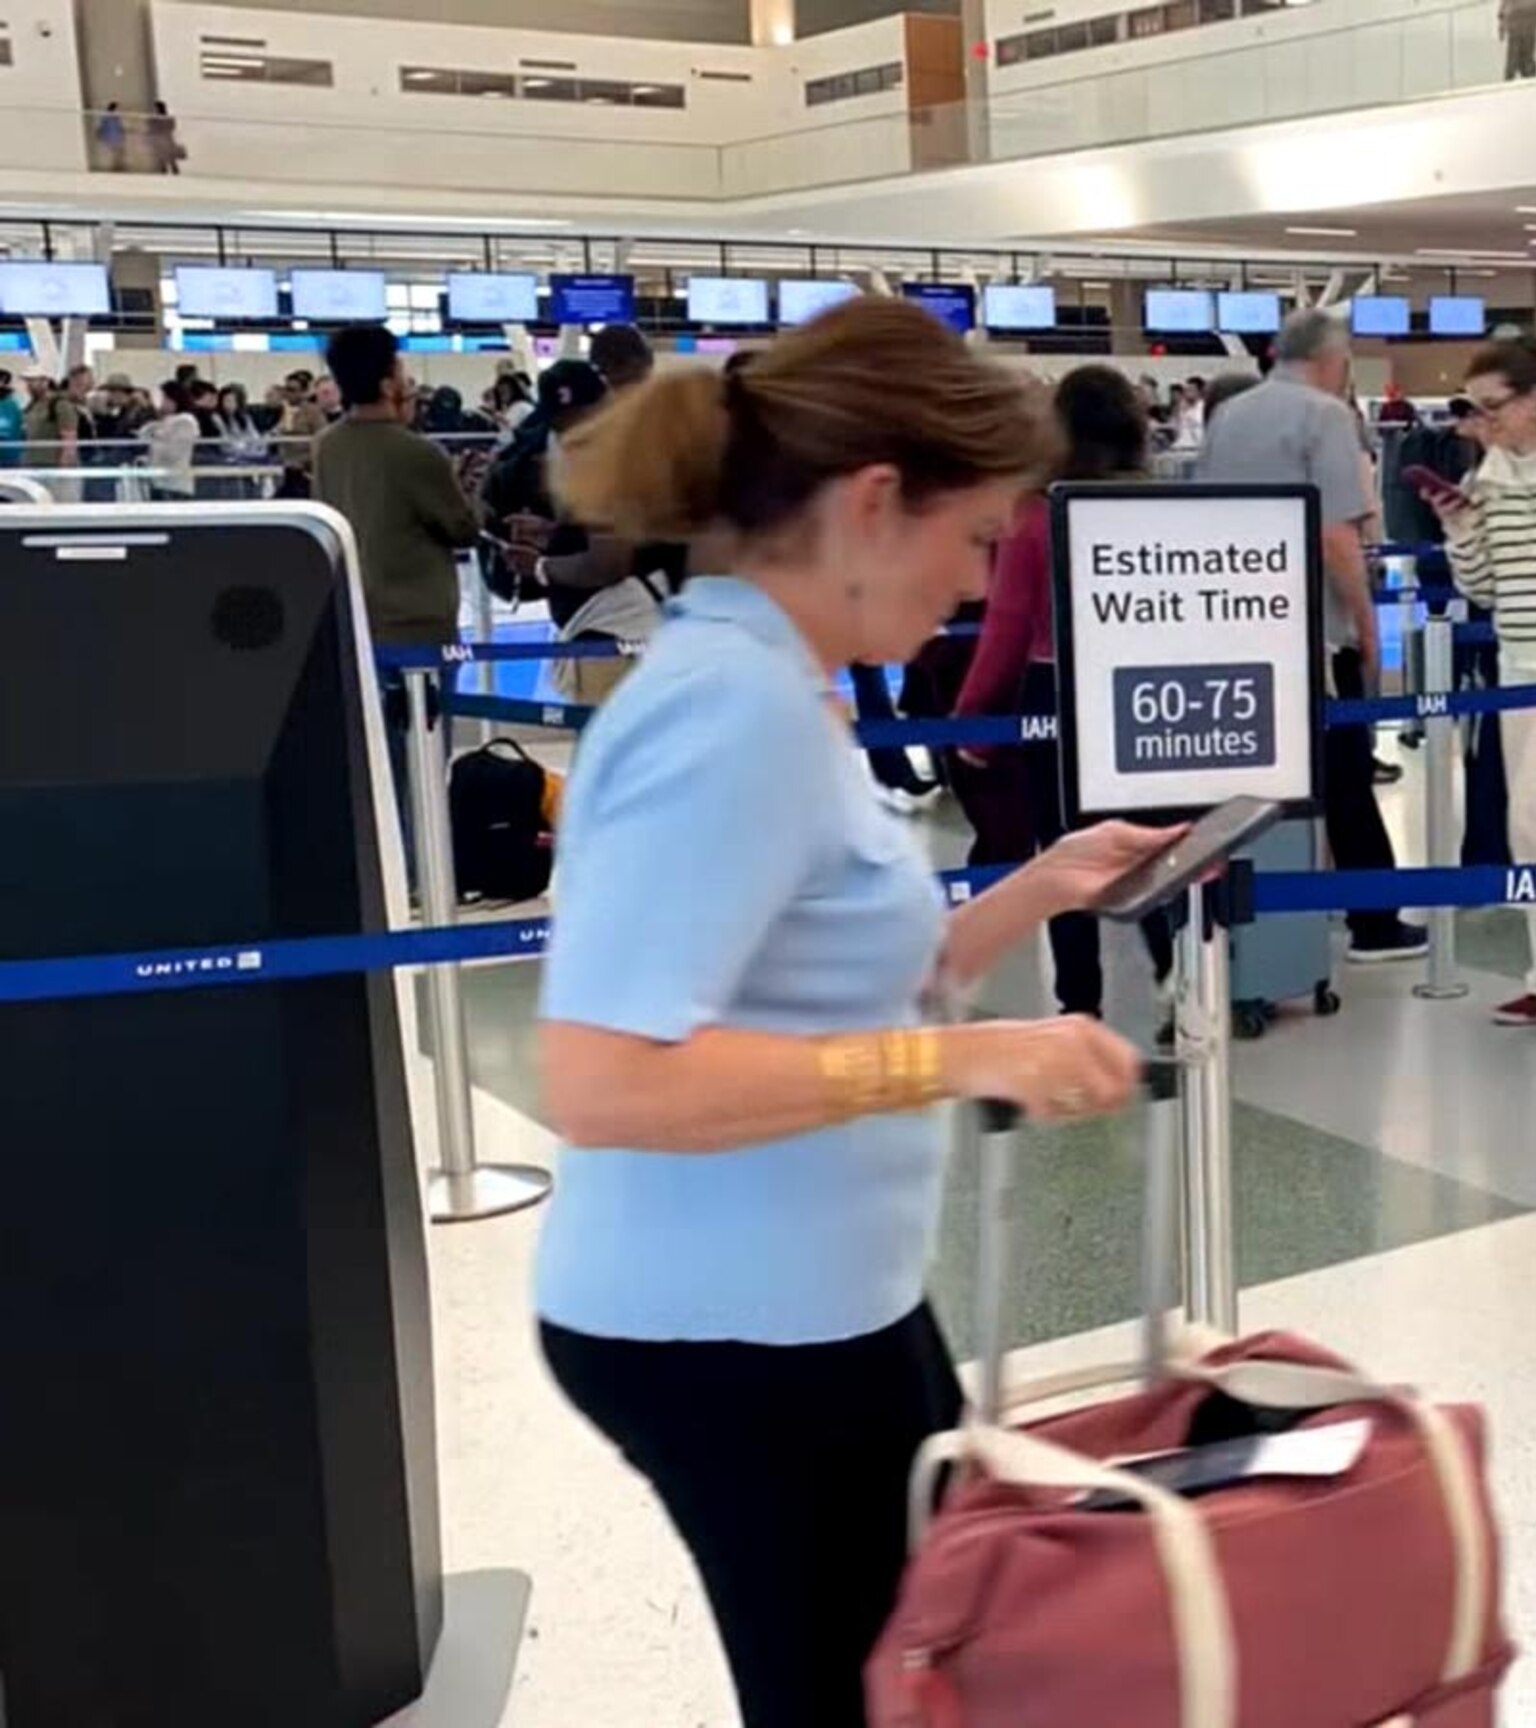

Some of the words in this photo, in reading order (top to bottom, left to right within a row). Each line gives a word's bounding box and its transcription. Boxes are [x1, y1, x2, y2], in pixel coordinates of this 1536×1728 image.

[1092, 541, 1288, 575] Estimated
[1091, 590, 1185, 623] Wait
[1198, 589, 1290, 621] Time
[1131, 679, 1257, 724] 60-75
[1416, 695, 1447, 714] IAH
[1021, 715, 1057, 740] IAH
[1135, 727, 1258, 759] minutes
[136, 957, 232, 976] UNITED
